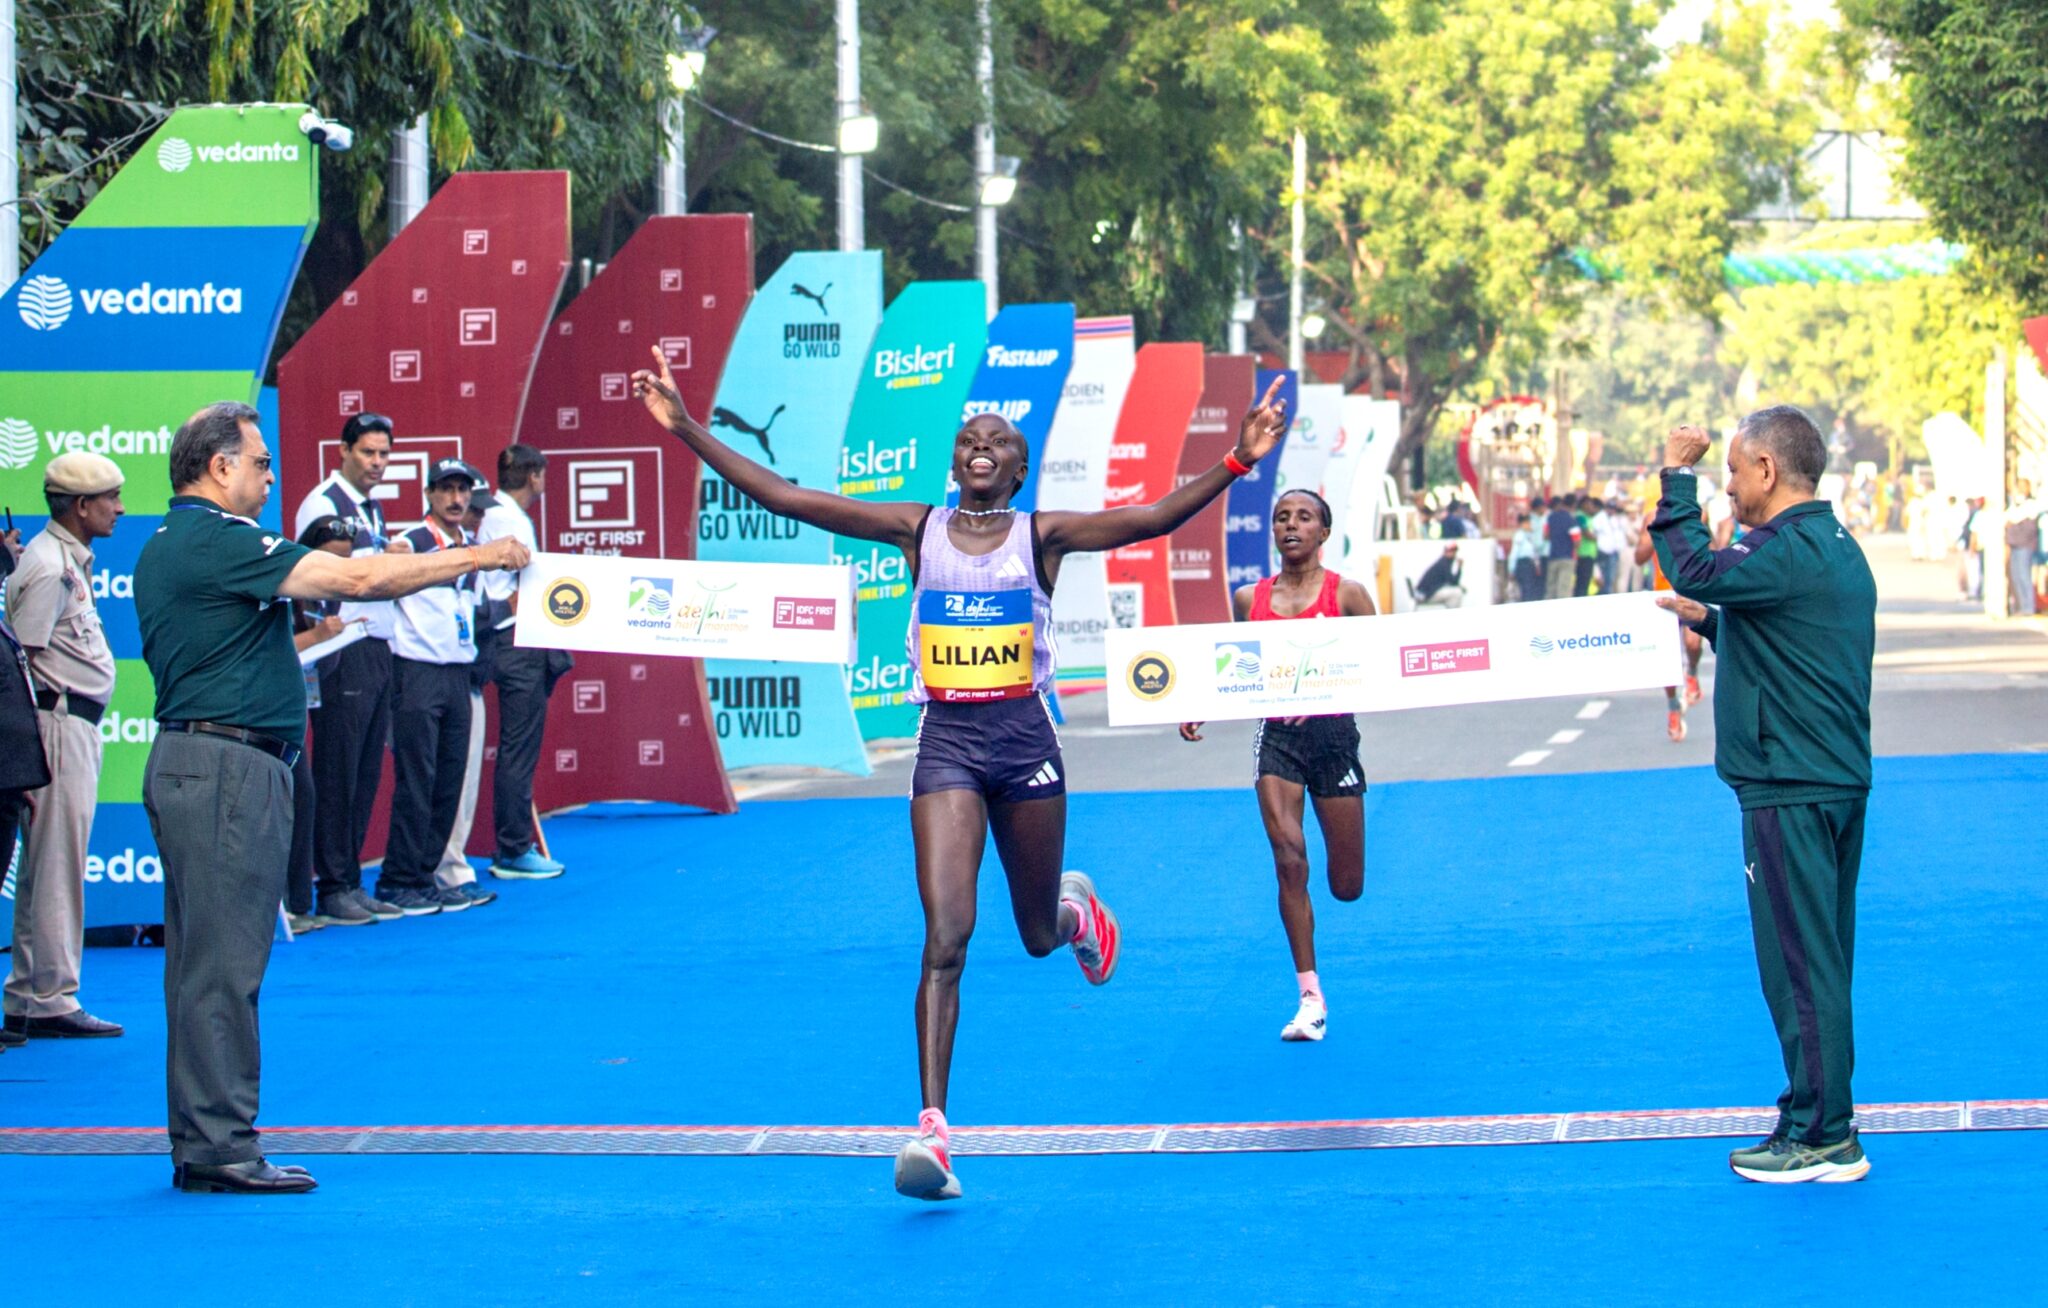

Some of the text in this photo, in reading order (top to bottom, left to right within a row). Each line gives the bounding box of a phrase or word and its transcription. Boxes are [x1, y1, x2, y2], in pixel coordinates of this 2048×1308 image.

[196, 141, 298, 163] vedanta
[80, 282, 242, 314] vedanta
[784, 323, 840, 342] PUMA
[784, 342, 840, 358] GO WILD
[875, 342, 955, 378] Bisleri
[45, 424, 172, 454] vedant
[842, 438, 917, 478] isleri
[699, 513, 799, 541] GO WILD
[560, 530, 646, 547] IDFC FIRST
[1171, 549, 1212, 562] ETRO
[92, 569, 134, 598] da
[796, 605, 834, 616] IDFC FIRST
[627, 618, 671, 629] vedanta
[796, 616, 815, 626] Bank
[1057, 619, 1108, 634] RIDIEN
[1557, 631, 1631, 650] vedanta
[932, 643, 1020, 665] LILIAN
[1431, 647, 1485, 661] IDFC FIRST
[1431, 660, 1456, 671] Bank
[706, 676, 800, 709] PUMA
[1217, 682, 1264, 694] vedanta
[716, 711, 801, 739] O WILD
[84, 848, 164, 883] eda
